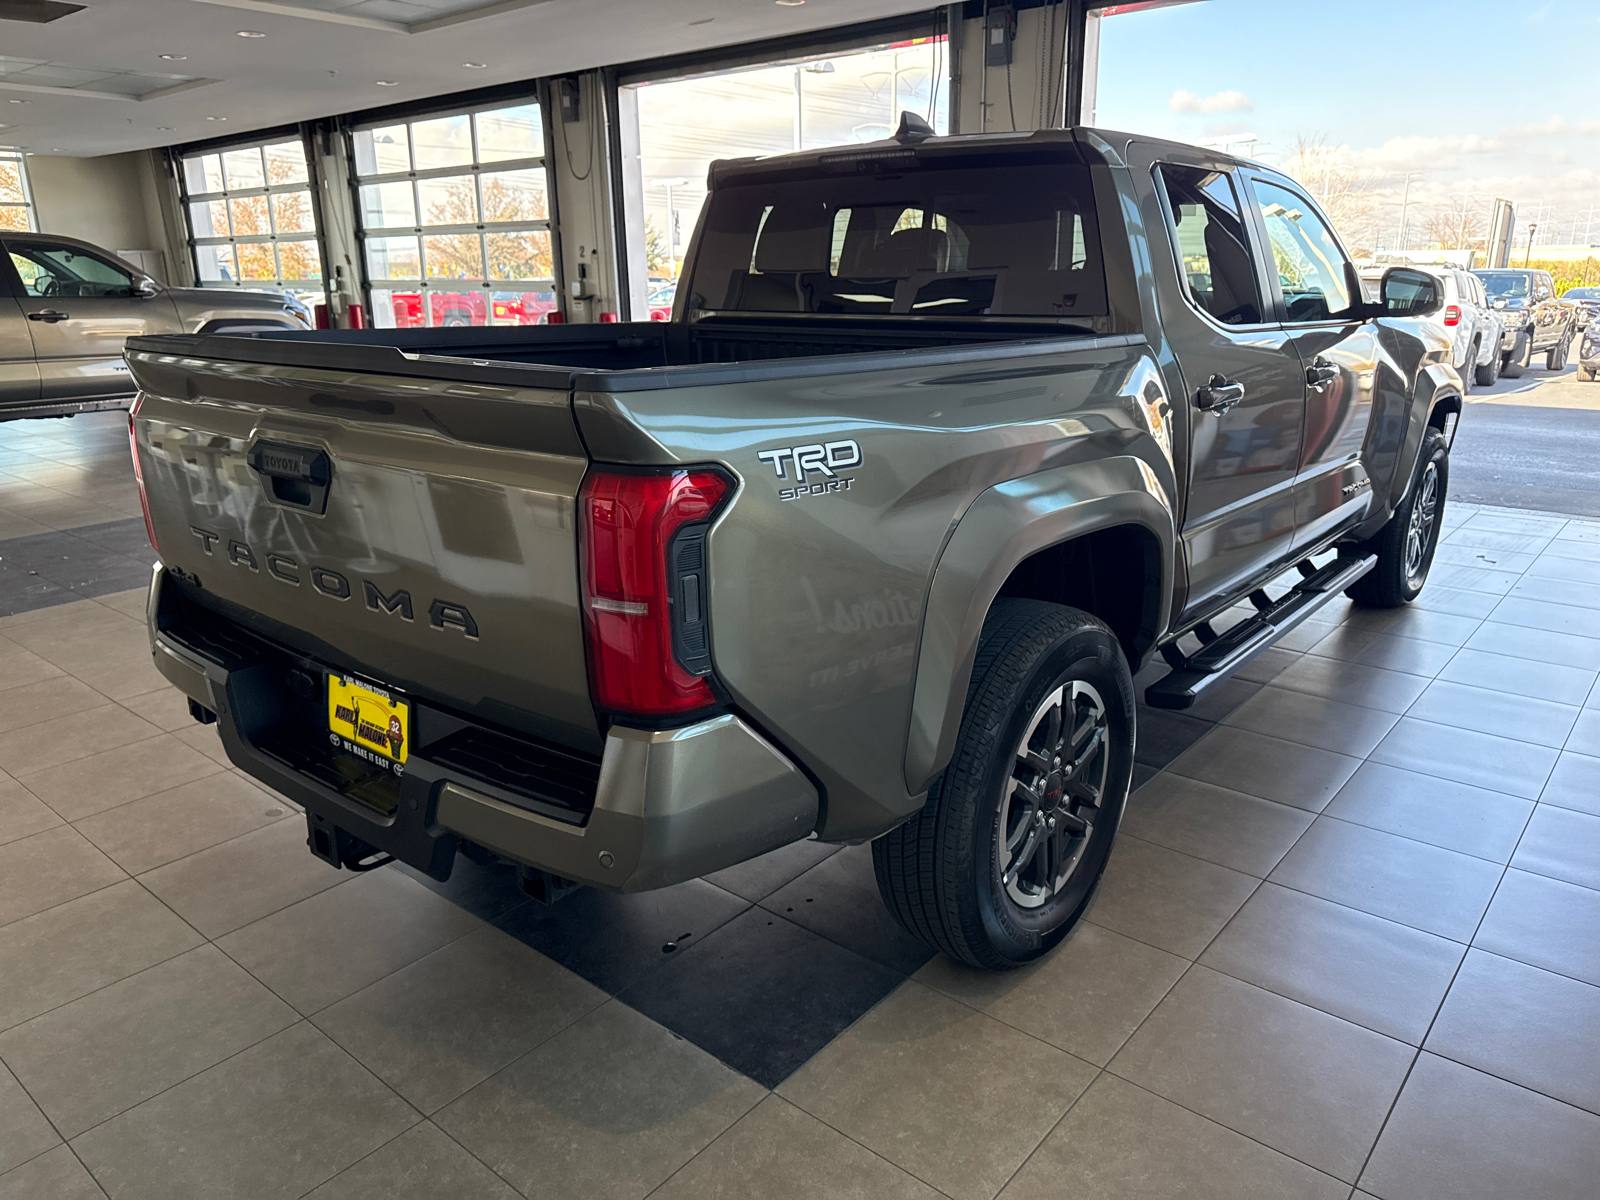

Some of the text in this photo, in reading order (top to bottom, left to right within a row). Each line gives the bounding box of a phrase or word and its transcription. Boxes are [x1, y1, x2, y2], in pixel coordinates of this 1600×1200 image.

[579, 245, 585, 258] 2
[264, 454, 301, 473] TOYOTA
[757, 439, 864, 486] TRD
[778, 478, 855, 501] SPORT
[190, 526, 480, 642] TACOMA
[355, 679, 373, 692] MALONE
[335, 703, 356, 725] KARL
[358, 723, 388, 749] MALONE
[390, 720, 400, 734] 32
[343, 740, 389, 769] WE MAKE IT EASY
